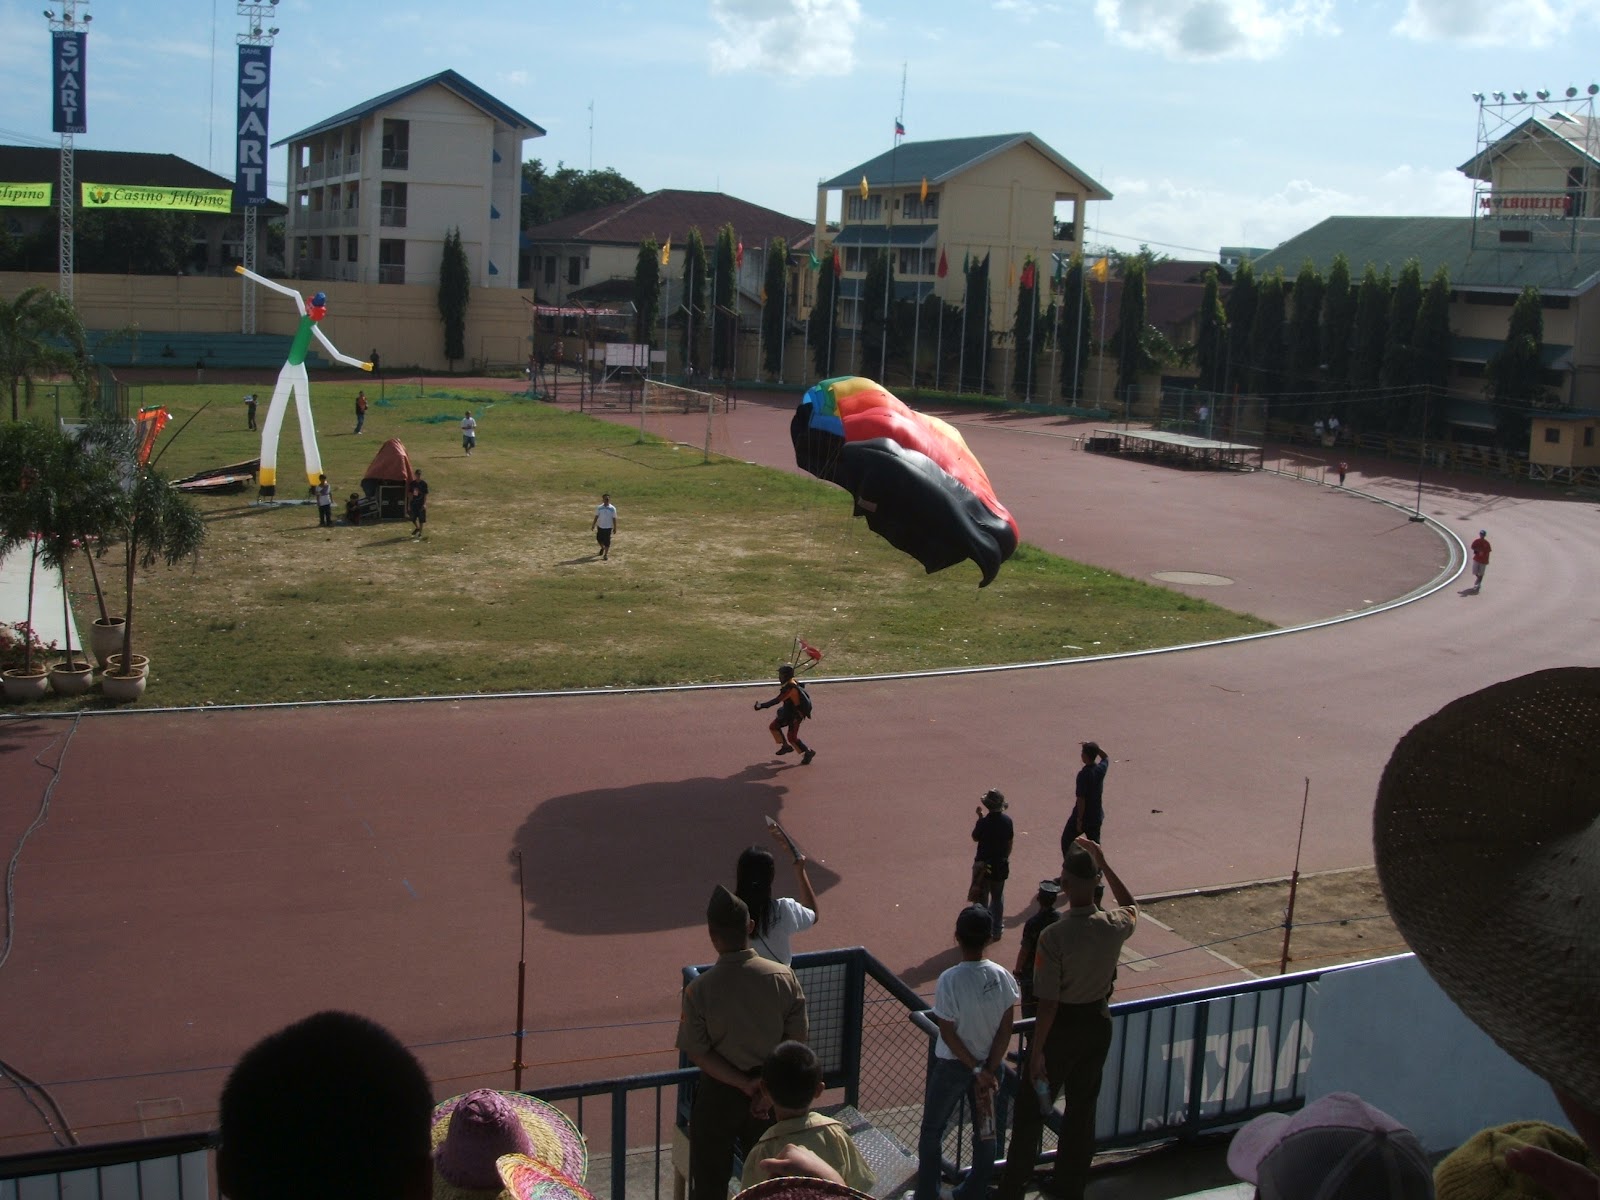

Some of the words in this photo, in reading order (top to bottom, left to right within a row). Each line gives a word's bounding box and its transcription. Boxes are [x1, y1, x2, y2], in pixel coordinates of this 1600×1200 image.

[60, 40, 80, 124] SMART
[239, 61, 267, 192] SMART
[0, 186, 45, 202] lipino
[113, 188, 163, 202] Casino
[166, 190, 224, 206] Filipino
